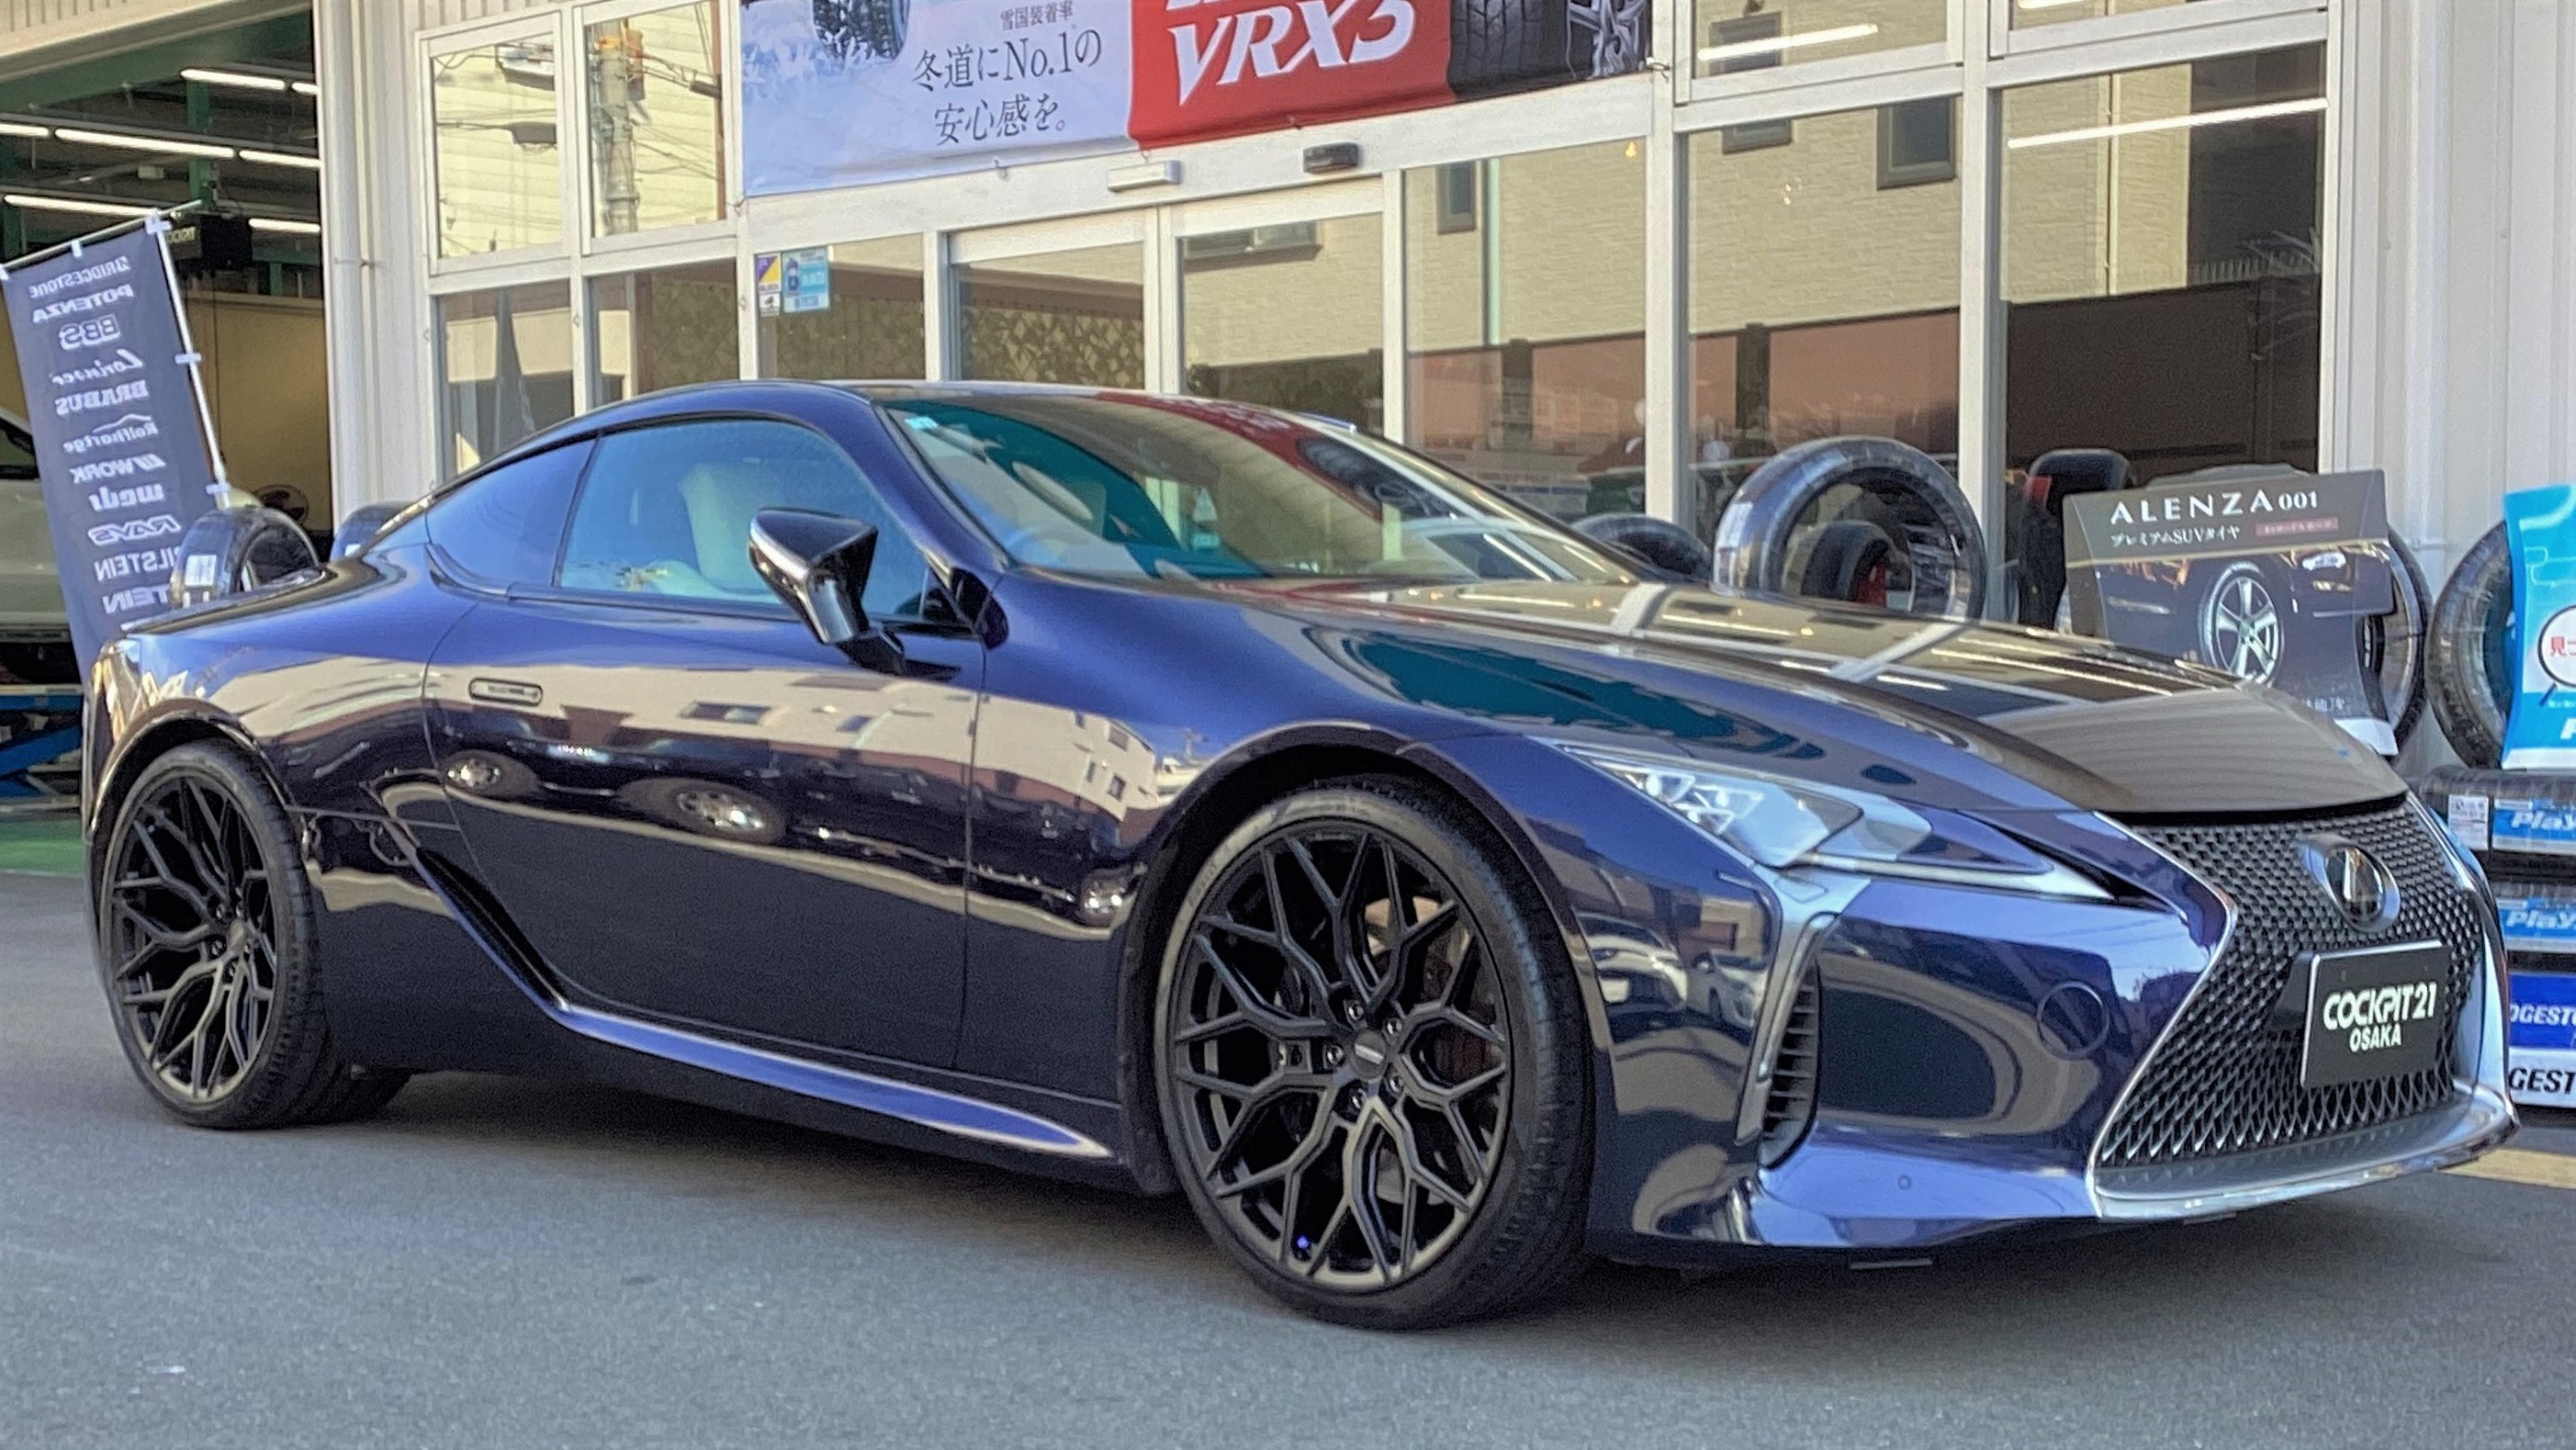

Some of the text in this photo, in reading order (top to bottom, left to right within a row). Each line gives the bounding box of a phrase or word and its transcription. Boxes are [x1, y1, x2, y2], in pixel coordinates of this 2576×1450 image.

[912, 29, 1101, 91] 冬道にNo.1の
[1167, 0, 1414, 106] VRX3
[935, 93, 1066, 146] 安心感を。
[2110, 489, 2318, 525] ALENZA 001
[2349, 1024, 2402, 1053] OSAKA
